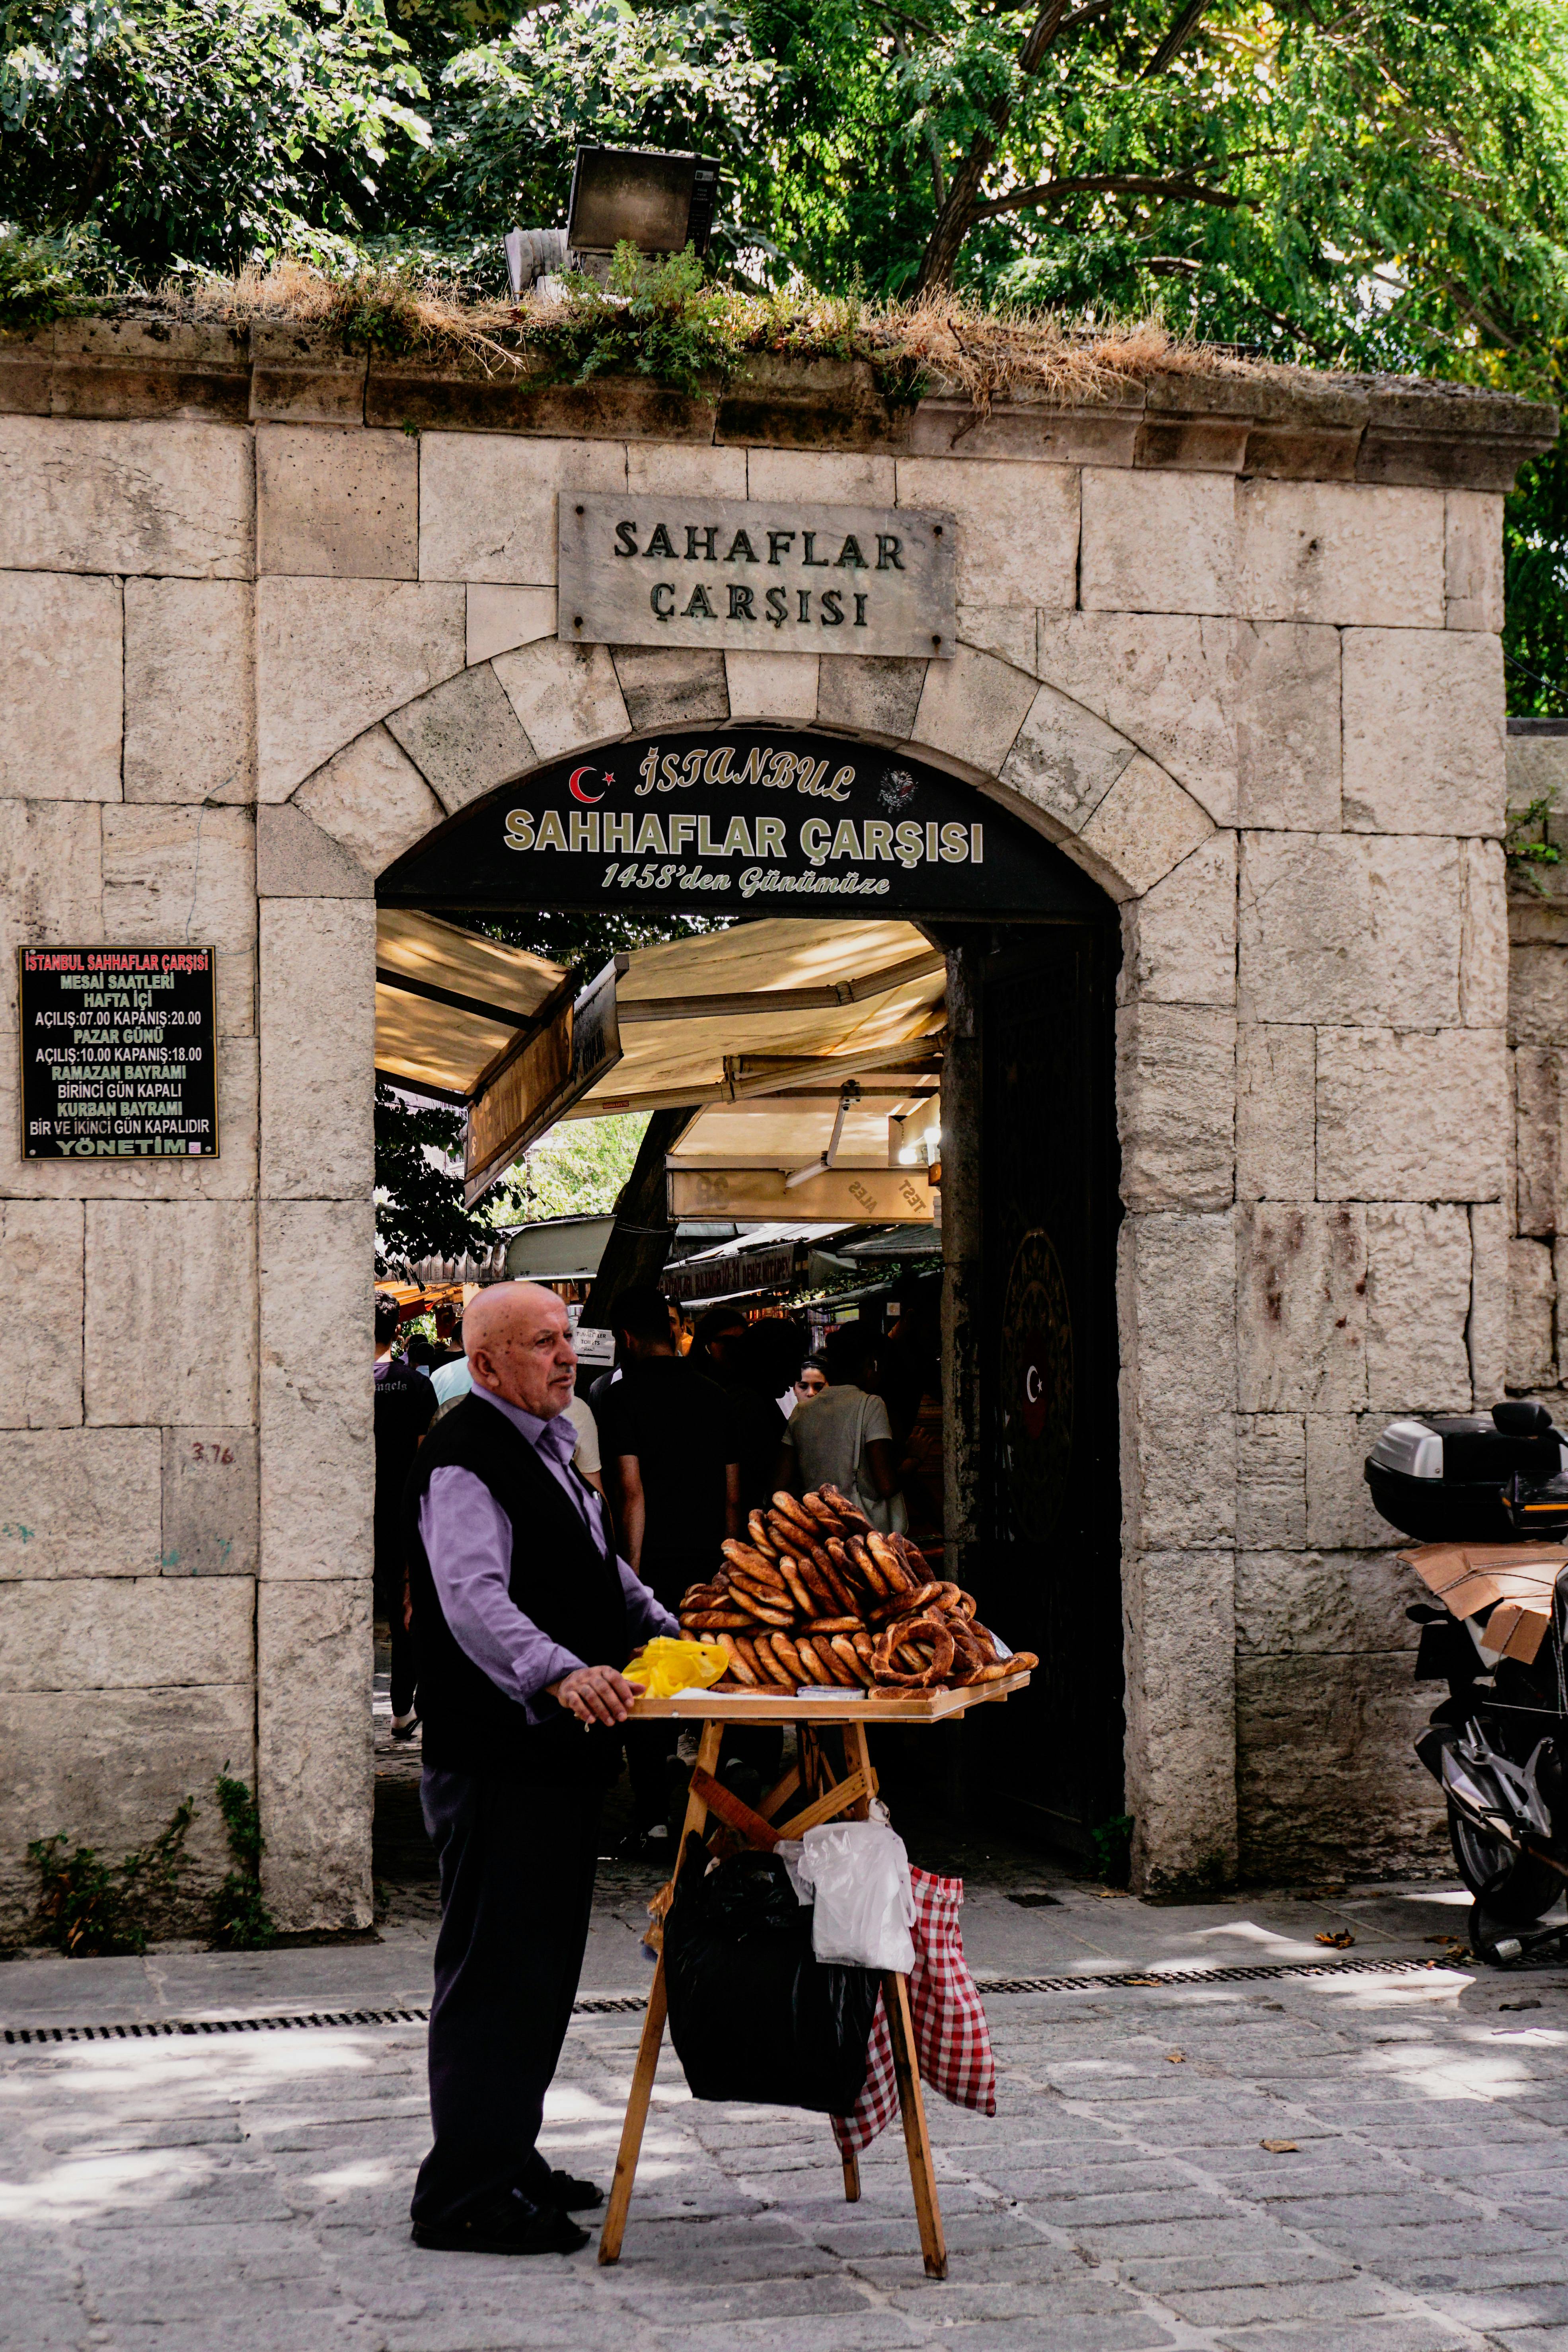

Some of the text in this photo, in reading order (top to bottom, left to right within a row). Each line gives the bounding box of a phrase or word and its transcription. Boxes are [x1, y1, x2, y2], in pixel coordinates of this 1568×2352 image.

[614, 521, 905, 570] SAHAFLAR
[650, 582, 868, 628] ÇARŞISI
[635, 747, 855, 801] İSTANBUL
[503, 808, 983, 868] SAHHAFLAR ÇARŞISI
[738, 866, 890, 898] Günümüze
[25, 951, 208, 974] İSTANBUL SAHHAFLAR ÇARŞISI
[61, 972, 174, 989] MESAİ SAATLERİ
[84, 990, 152, 1010] HAFTA İÇİ
[35, 1011, 201, 1028] AÇILIŞ:07.00 KAPANIŞ:20.00
[74, 1027, 164, 1043] PAZAR GÜNÜ
[36, 1047, 202, 1064] AÇILIŞ:10.00 KAPANIŞ:18.00
[52, 1065, 186, 1080] RAMAZAN BAYRAMI
[58, 1081, 181, 1098] BİRİNCİ GÜN KAPALI
[57, 1102, 182, 1117] KURBAN BAYRAMI
[30, 1117, 209, 1135] BİR VE İKİNCİ GÜN KAPALIDIR
[56, 1136, 186, 1155] YÖNETİM
[375, 1380, 407, 1393] ngels
